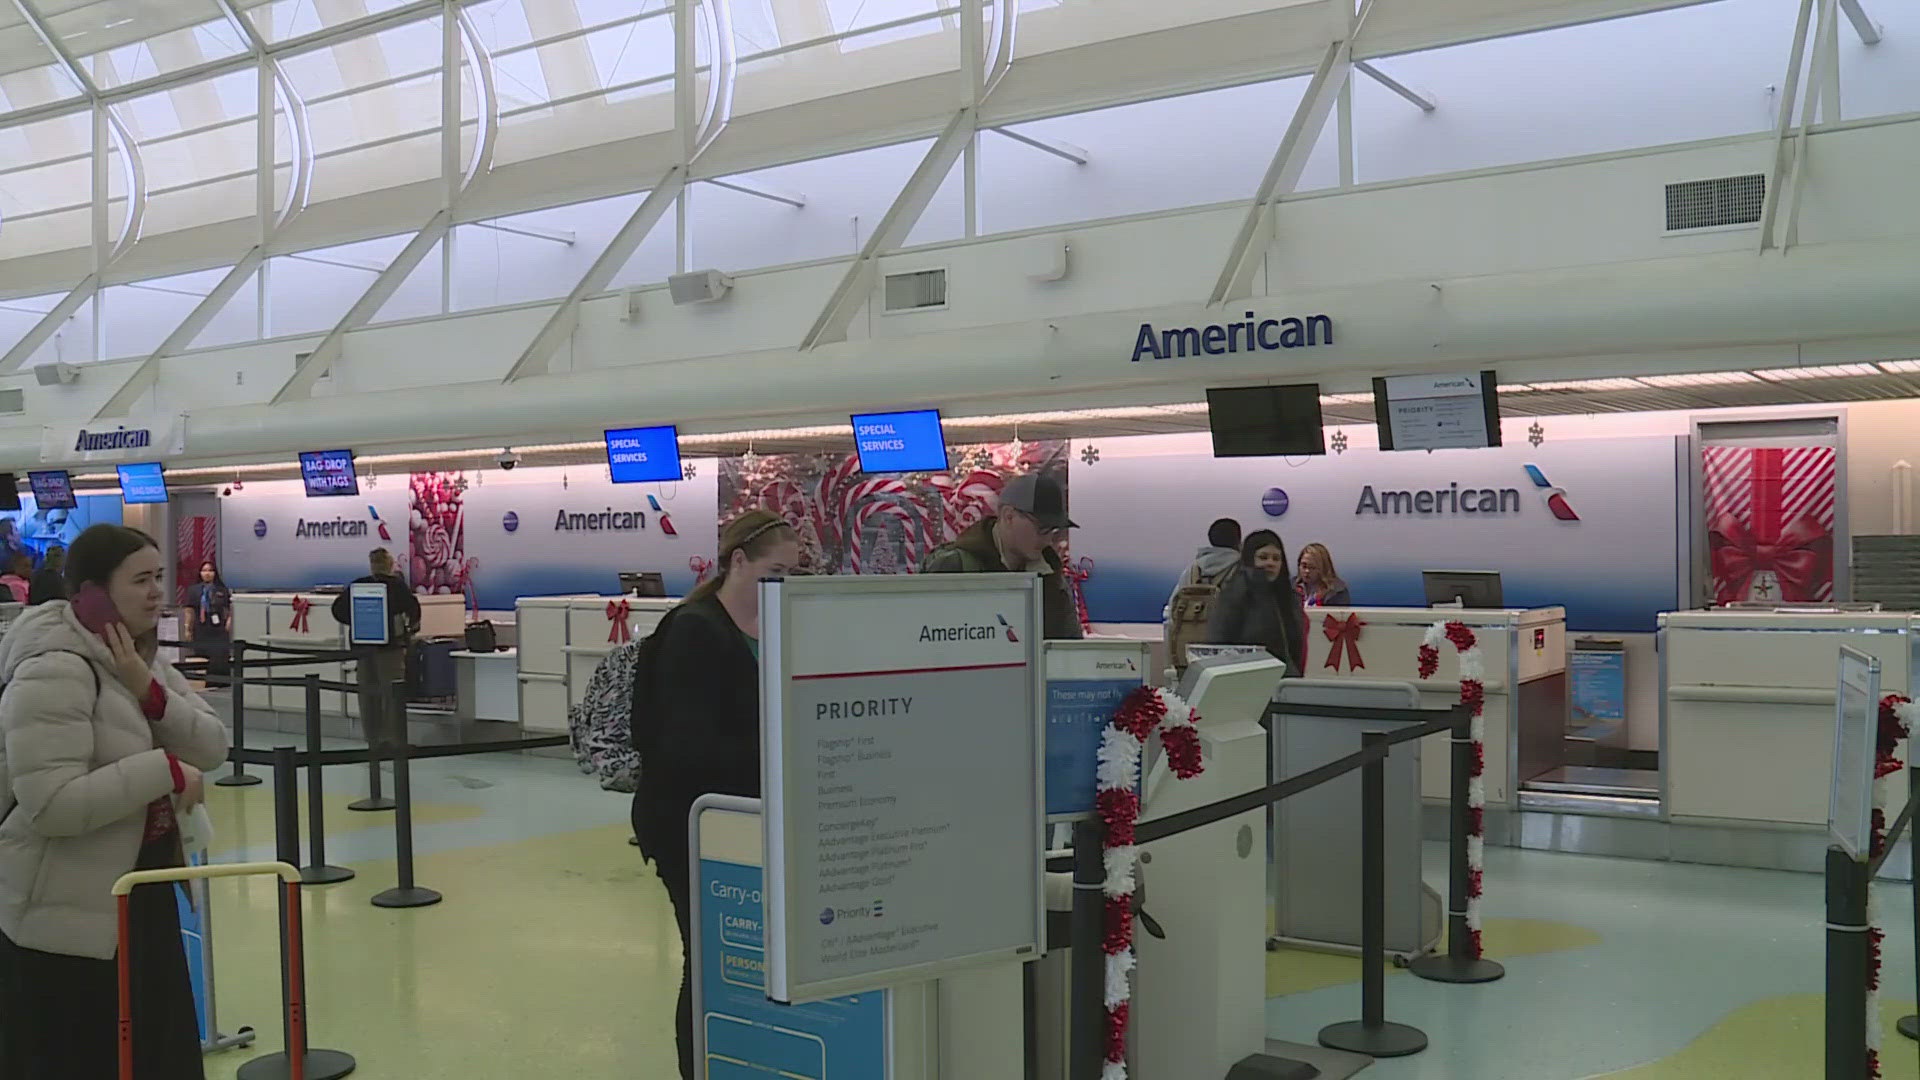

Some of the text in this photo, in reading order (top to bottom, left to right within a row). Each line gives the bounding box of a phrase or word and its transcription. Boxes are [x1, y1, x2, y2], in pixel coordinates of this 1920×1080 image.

[1131, 311, 1333, 362] American
[1398, 405, 1434, 415] PRIORITY
[858, 423, 896, 437] SPECIAL
[75, 425, 152, 452] American
[611, 438, 641, 449] SPECIAL
[861, 439, 905, 452] SERVICES
[612, 452, 648, 464] SERVICES
[305, 459, 347, 472] BAG DROP
[308, 475, 349, 488] WITH TAGS
[1355, 482, 1520, 515] American
[296, 516, 368, 537] American
[554, 507, 646, 532] American
[918, 623, 996, 643] American
[1095, 661, 1127, 670] American
[816, 697, 913, 720] PRIORITY
[857, 735, 875, 746] First
[836, 906, 871, 920] Priority
